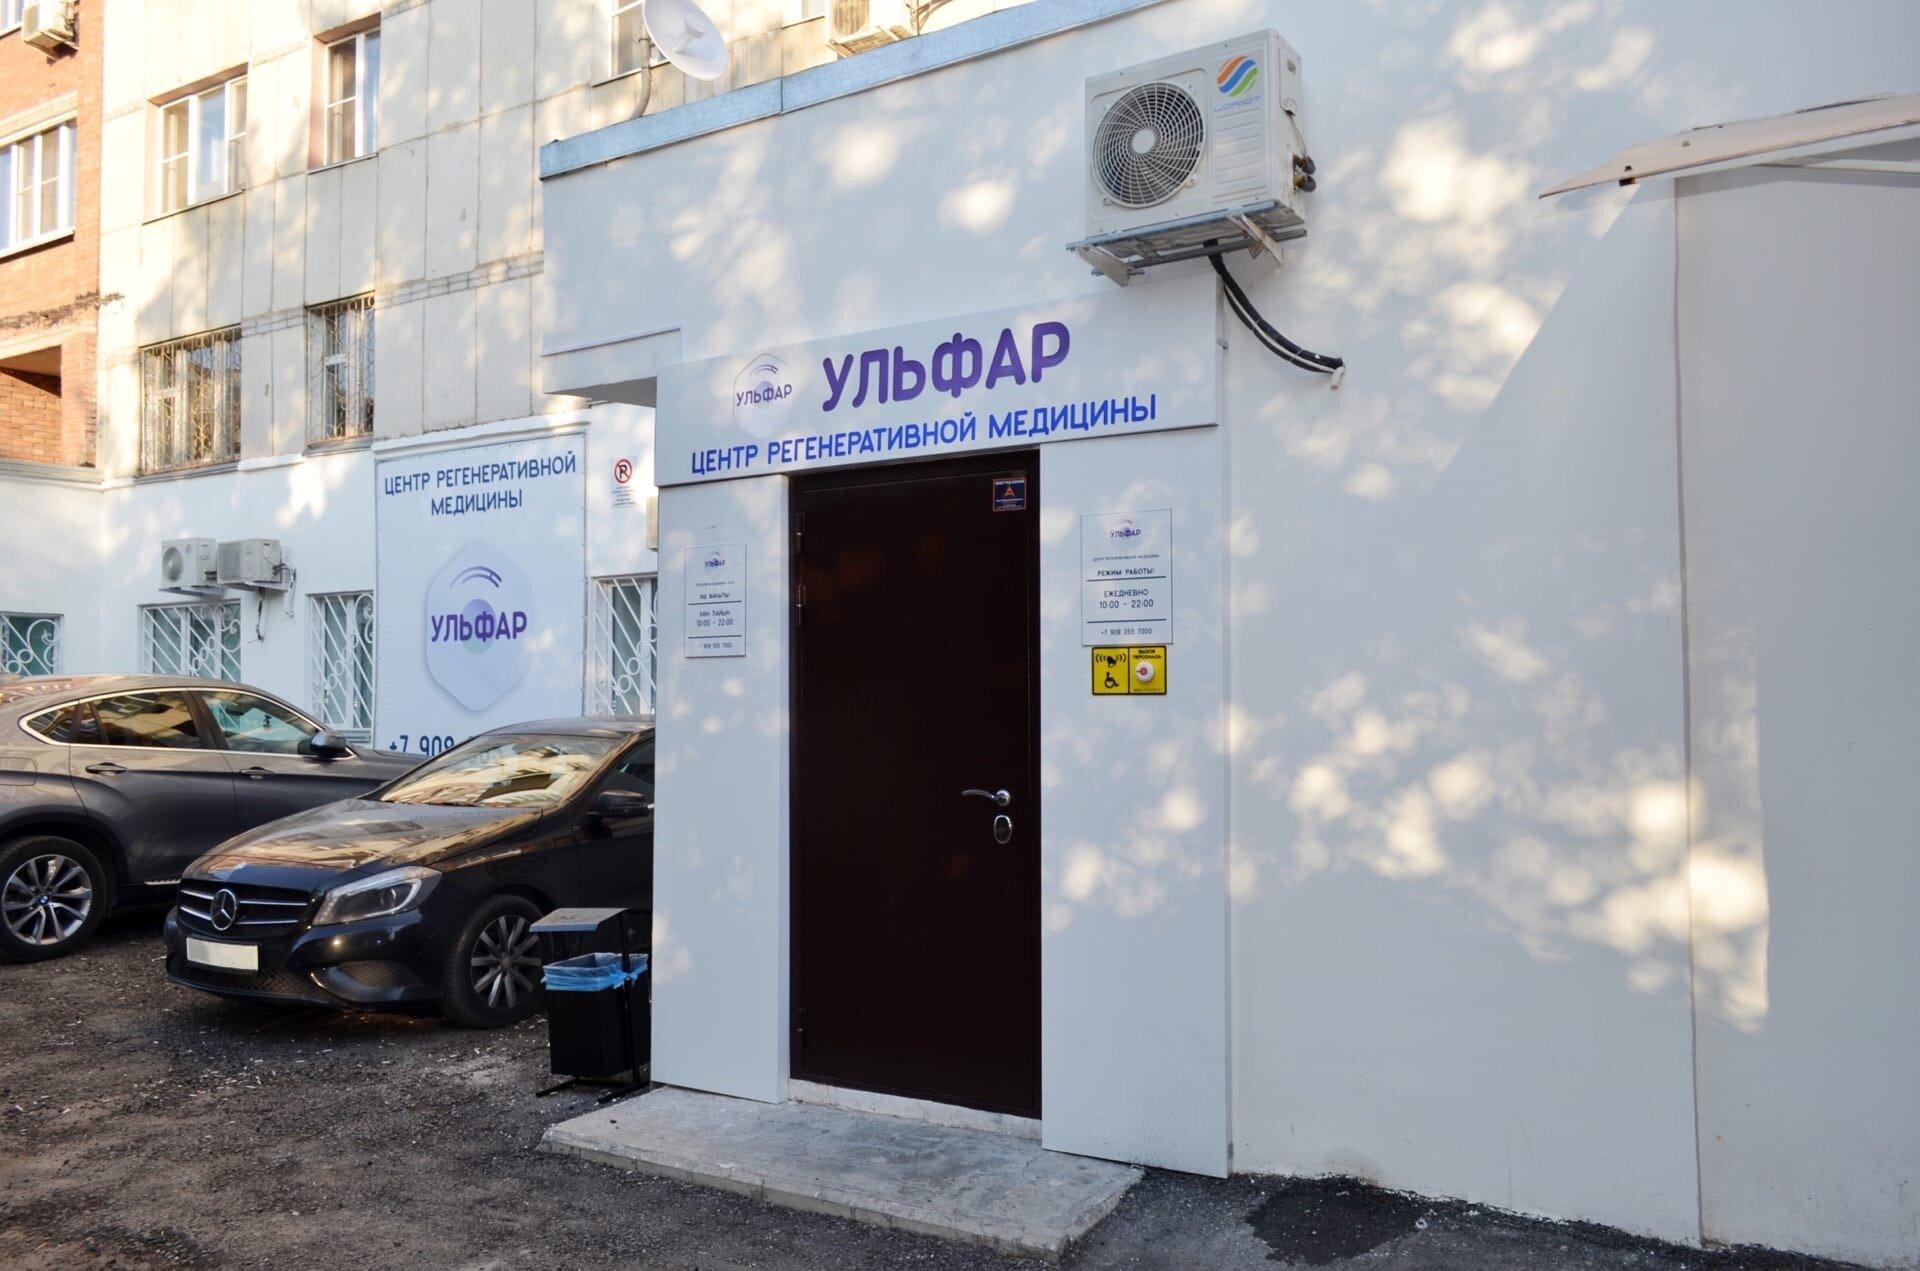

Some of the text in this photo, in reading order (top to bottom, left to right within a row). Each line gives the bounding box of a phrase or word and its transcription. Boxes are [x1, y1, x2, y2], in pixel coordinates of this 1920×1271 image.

[822, 321, 1071, 412] УЛЬФАР
[736, 383, 793, 407] УЛЬФАР
[691, 394, 1157, 475] ЦЕНТР РЕГЕНЕРАТИВНОЙ МЕДИЦИНЫ
[385, 451, 576, 495] ЦЕНТР РЕГЕНЕРАТИВНОЙ
[431, 489, 522, 516] МЕДИЦИНЫ
[431, 610, 528, 643] УЛЬФАР
